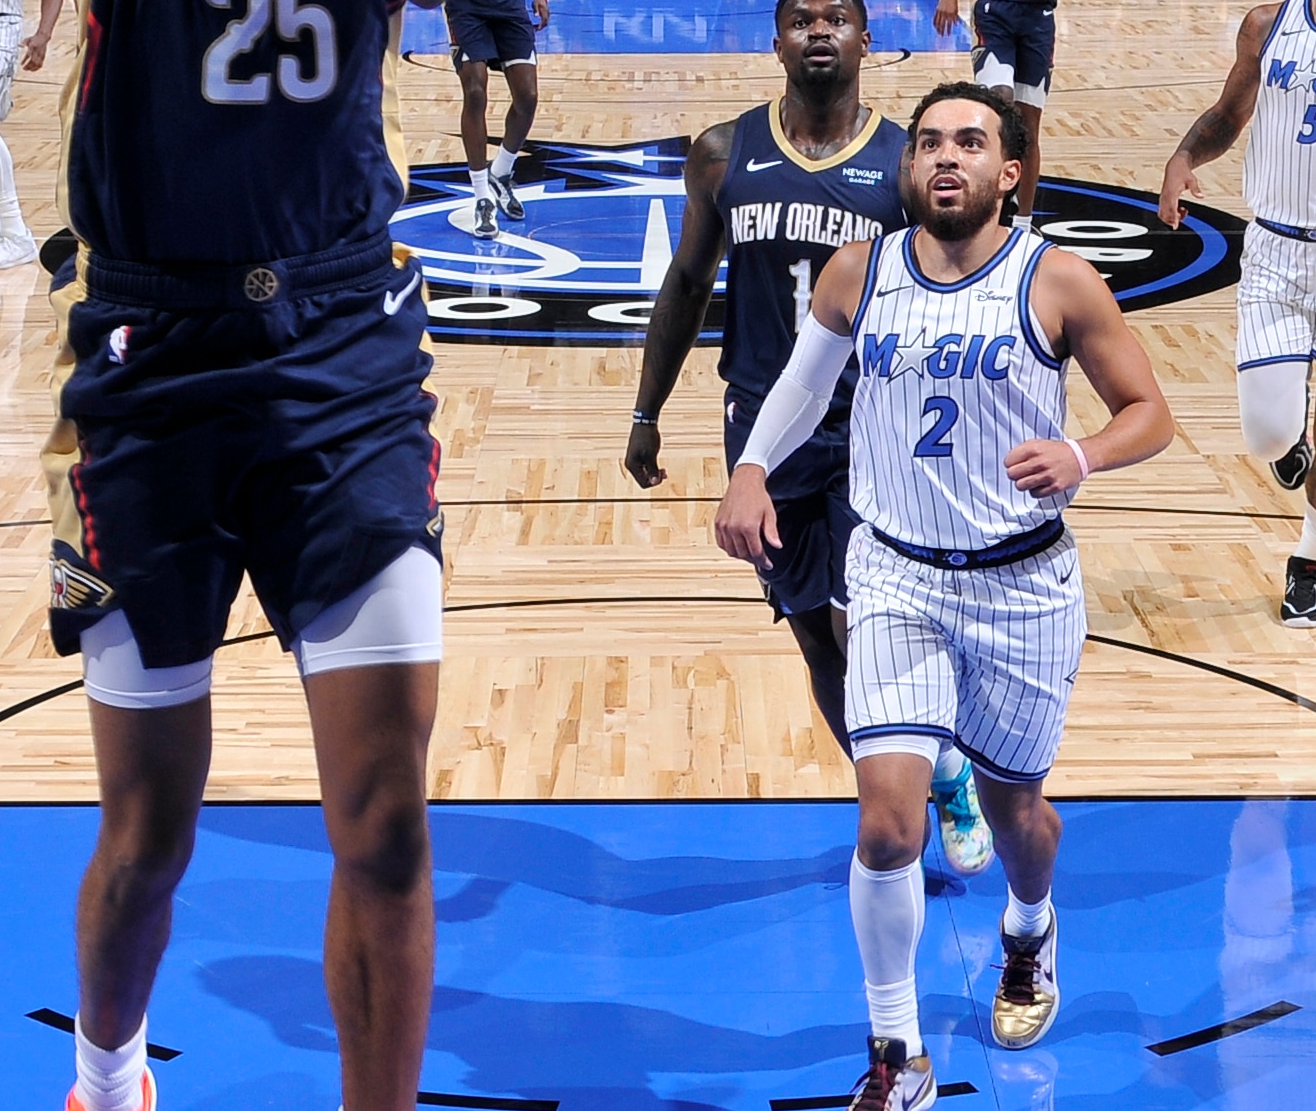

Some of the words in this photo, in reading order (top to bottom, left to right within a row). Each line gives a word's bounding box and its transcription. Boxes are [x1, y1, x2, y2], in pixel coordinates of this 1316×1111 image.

[842, 167, 884, 180] NEWAGE
[730, 205, 780, 245] NEW
[785, 201, 883, 248] ORLEANS
[789, 258, 813, 335] 1
[913, 395, 960, 458] 2
